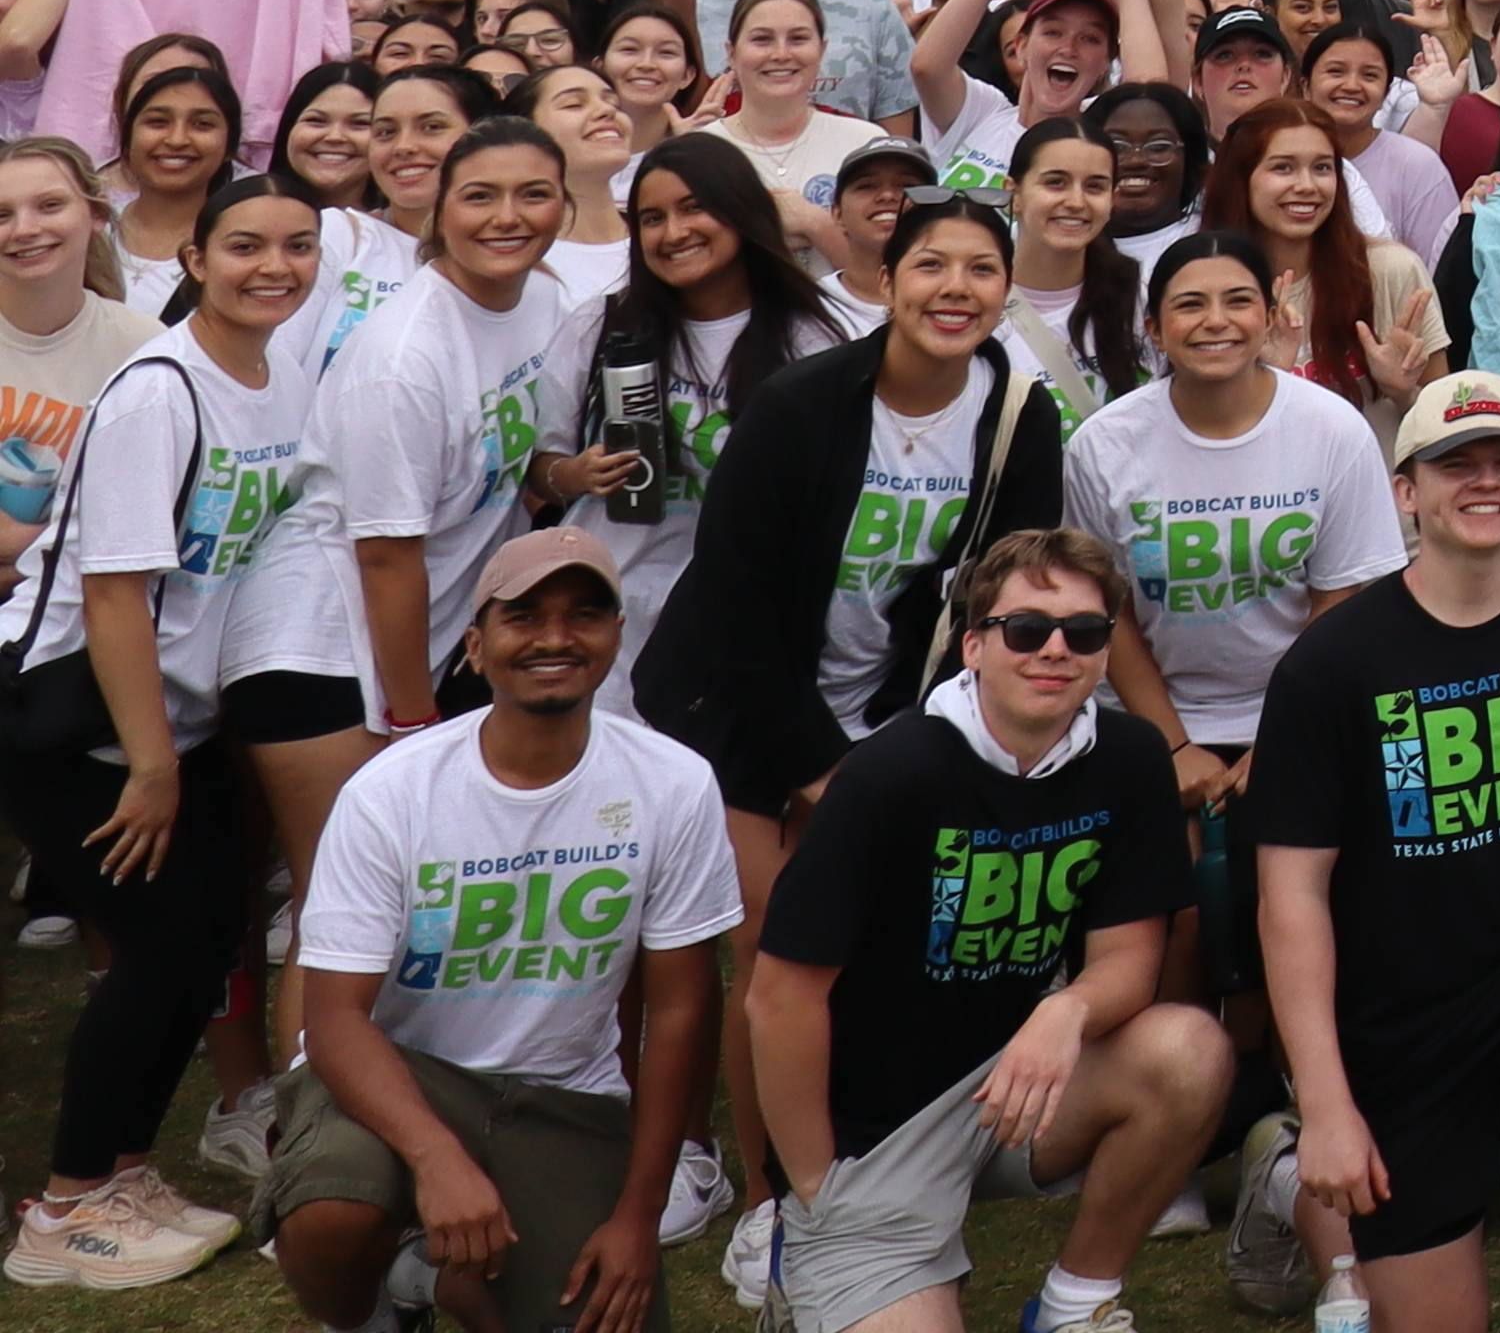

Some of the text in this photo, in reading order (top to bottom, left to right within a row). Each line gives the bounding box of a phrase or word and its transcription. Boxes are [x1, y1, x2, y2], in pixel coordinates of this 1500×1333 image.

[1167, 488, 1320, 515] BOBCAT BUILD'S
[1168, 511, 1316, 582] BIG
[1418, 673, 1500, 704] BOBCAT
[462, 842, 640, 877] BOBCAT BUILD'S
[1393, 842, 1445, 858] TEXAS
[1451, 830, 1494, 853] STATE
[961, 839, 1102, 926] BIG
[451, 867, 633, 951] BIG
[950, 916, 1071, 965] EVEN
[441, 938, 623, 990] EVENT
[65, 1234, 119, 1259] HOKA
